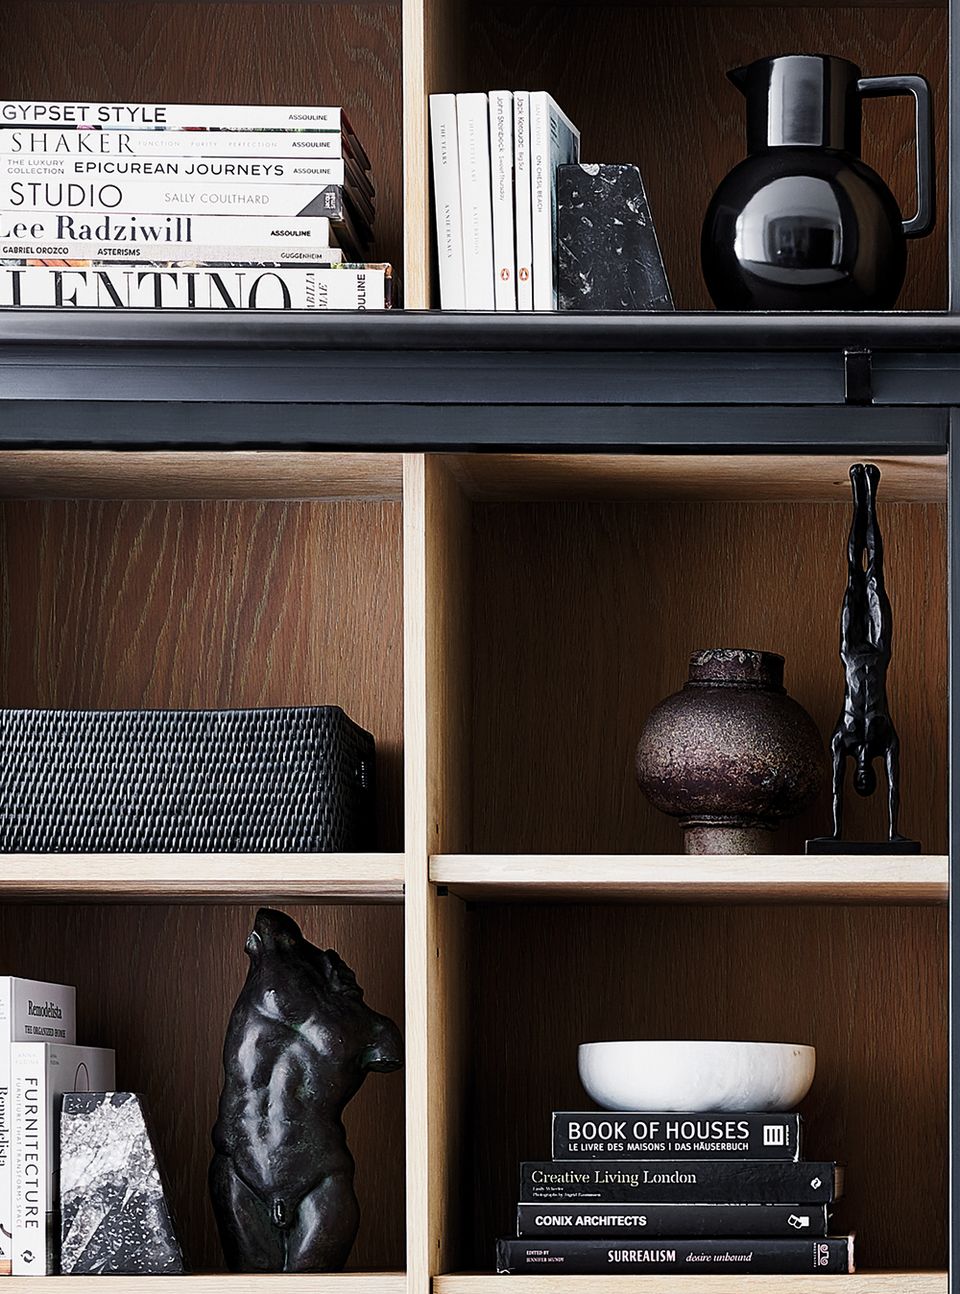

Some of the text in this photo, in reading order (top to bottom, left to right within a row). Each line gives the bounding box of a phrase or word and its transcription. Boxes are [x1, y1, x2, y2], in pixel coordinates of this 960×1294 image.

[2, 104, 90, 121] GYPSET
[98, 106, 167, 123] STYLE
[516, 97, 526, 148] Jack Kerouac
[11, 132, 134, 154] SHAKER
[74, 162, 179, 175] EPICUREAN
[185, 163, 284, 176] JOURNEYS
[536, 155, 543, 166] ON
[10, 182, 270, 208] STUDIO SALLY COULTHARD
[56, 215, 192, 242] Radziwill
[2, 246, 323, 260] GABRIEL OROZCO ASTERISMS GUGGENHEIM
[28, 1000, 63, 1020] Remodelista
[568, 1121, 750, 1140] BOOK OF HOUSES
[24, 1077, 39, 1229] FURNITECTURE
[568, 1143, 579, 1152] LE
[580, 1142, 604, 1152] LIVRE
[607, 1142, 624, 1152] DES
[627, 1142, 666, 1152] MAISONS
[675, 1142, 692, 1151] DAS
[531, 1170, 697, 1188] Creative Living London
[535, 1215, 648, 1227] CONIX ARCHITECTS
[607, 1250, 753, 1263] SURREALISM desire unbound
